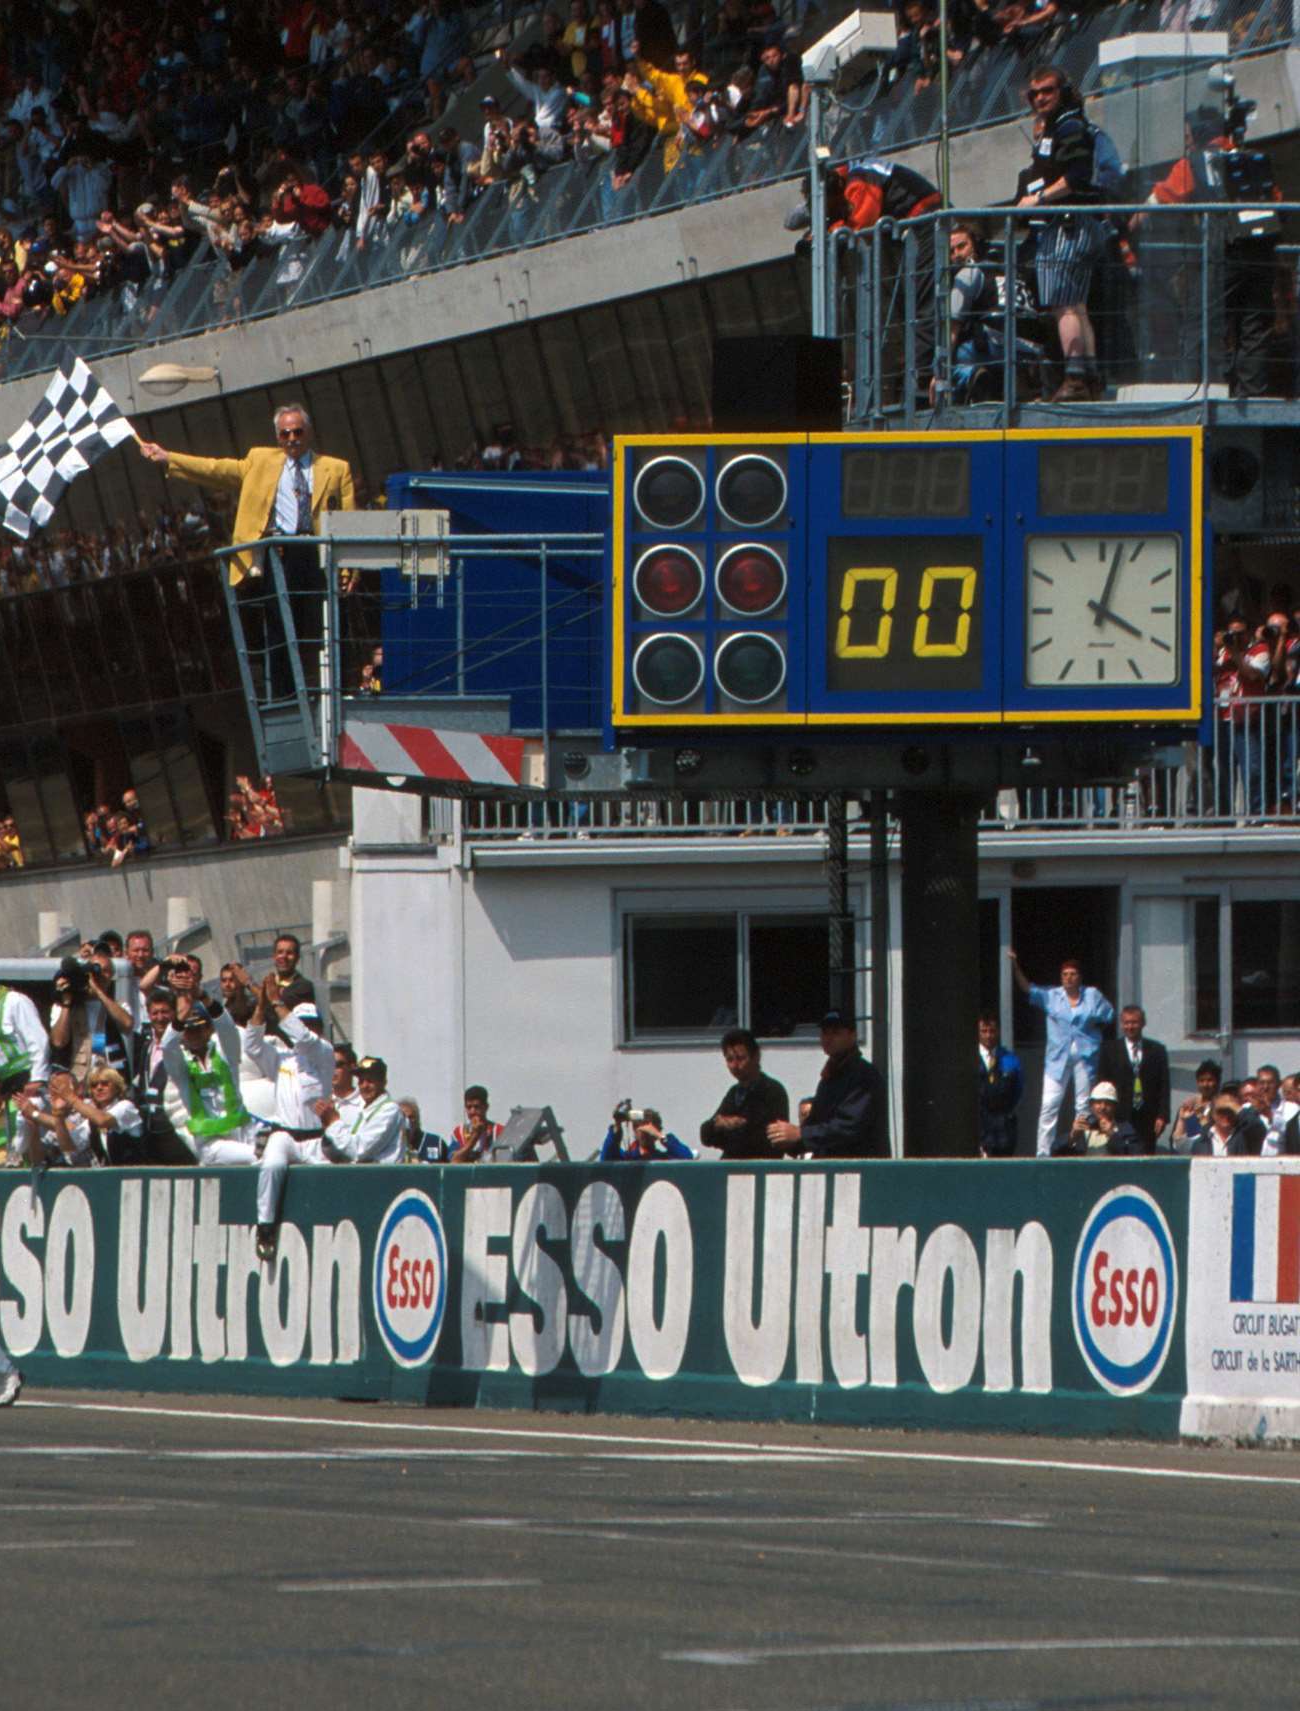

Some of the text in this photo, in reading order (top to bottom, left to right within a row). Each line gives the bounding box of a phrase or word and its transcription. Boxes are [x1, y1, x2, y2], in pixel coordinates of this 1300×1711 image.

[836, 566, 978, 659] 00
[117, 1177, 362, 1368] Ultron
[386, 1243, 435, 1310] Esso
[461, 1172, 1054, 1394] ESSO Ultron
[1090, 1250, 1159, 1328] Esso
[1211, 1349, 1243, 1371] CIRCUIT
[1247, 1349, 1259, 1372] de
[1261, 1349, 1270, 1373] la
[1233, 1312, 1266, 1335] CIRCUIT
